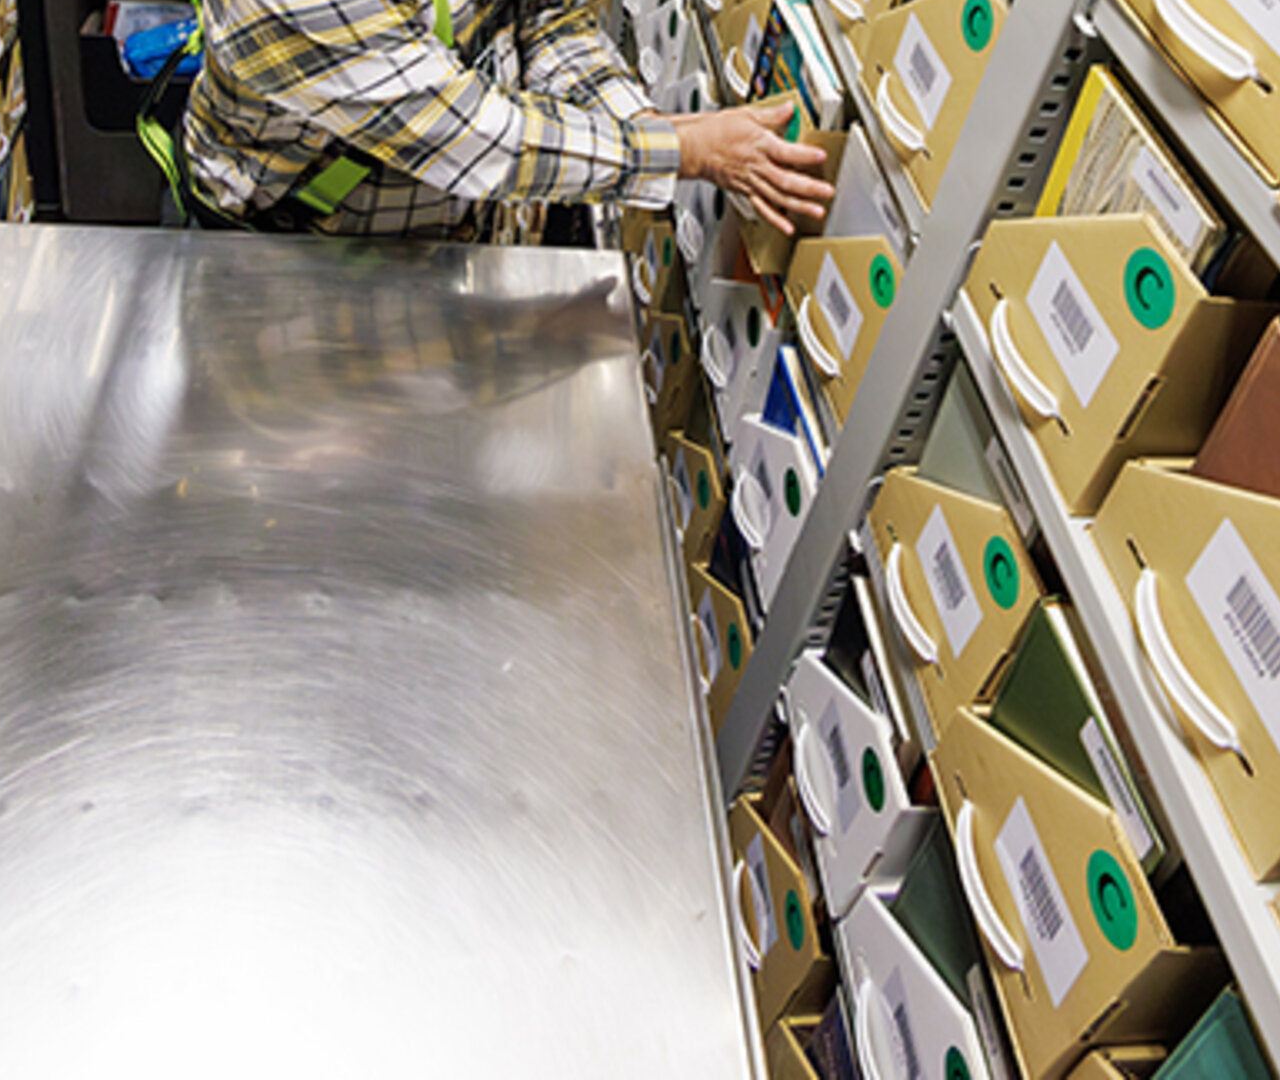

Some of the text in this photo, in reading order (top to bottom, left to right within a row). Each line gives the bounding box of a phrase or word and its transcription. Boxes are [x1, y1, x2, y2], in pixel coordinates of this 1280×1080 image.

[967, 5, 988, 38] C
[873, 266, 890, 296] C
[1134, 266, 1164, 310] C
[990, 551, 1011, 590] C
[1098, 872, 1127, 923] C
